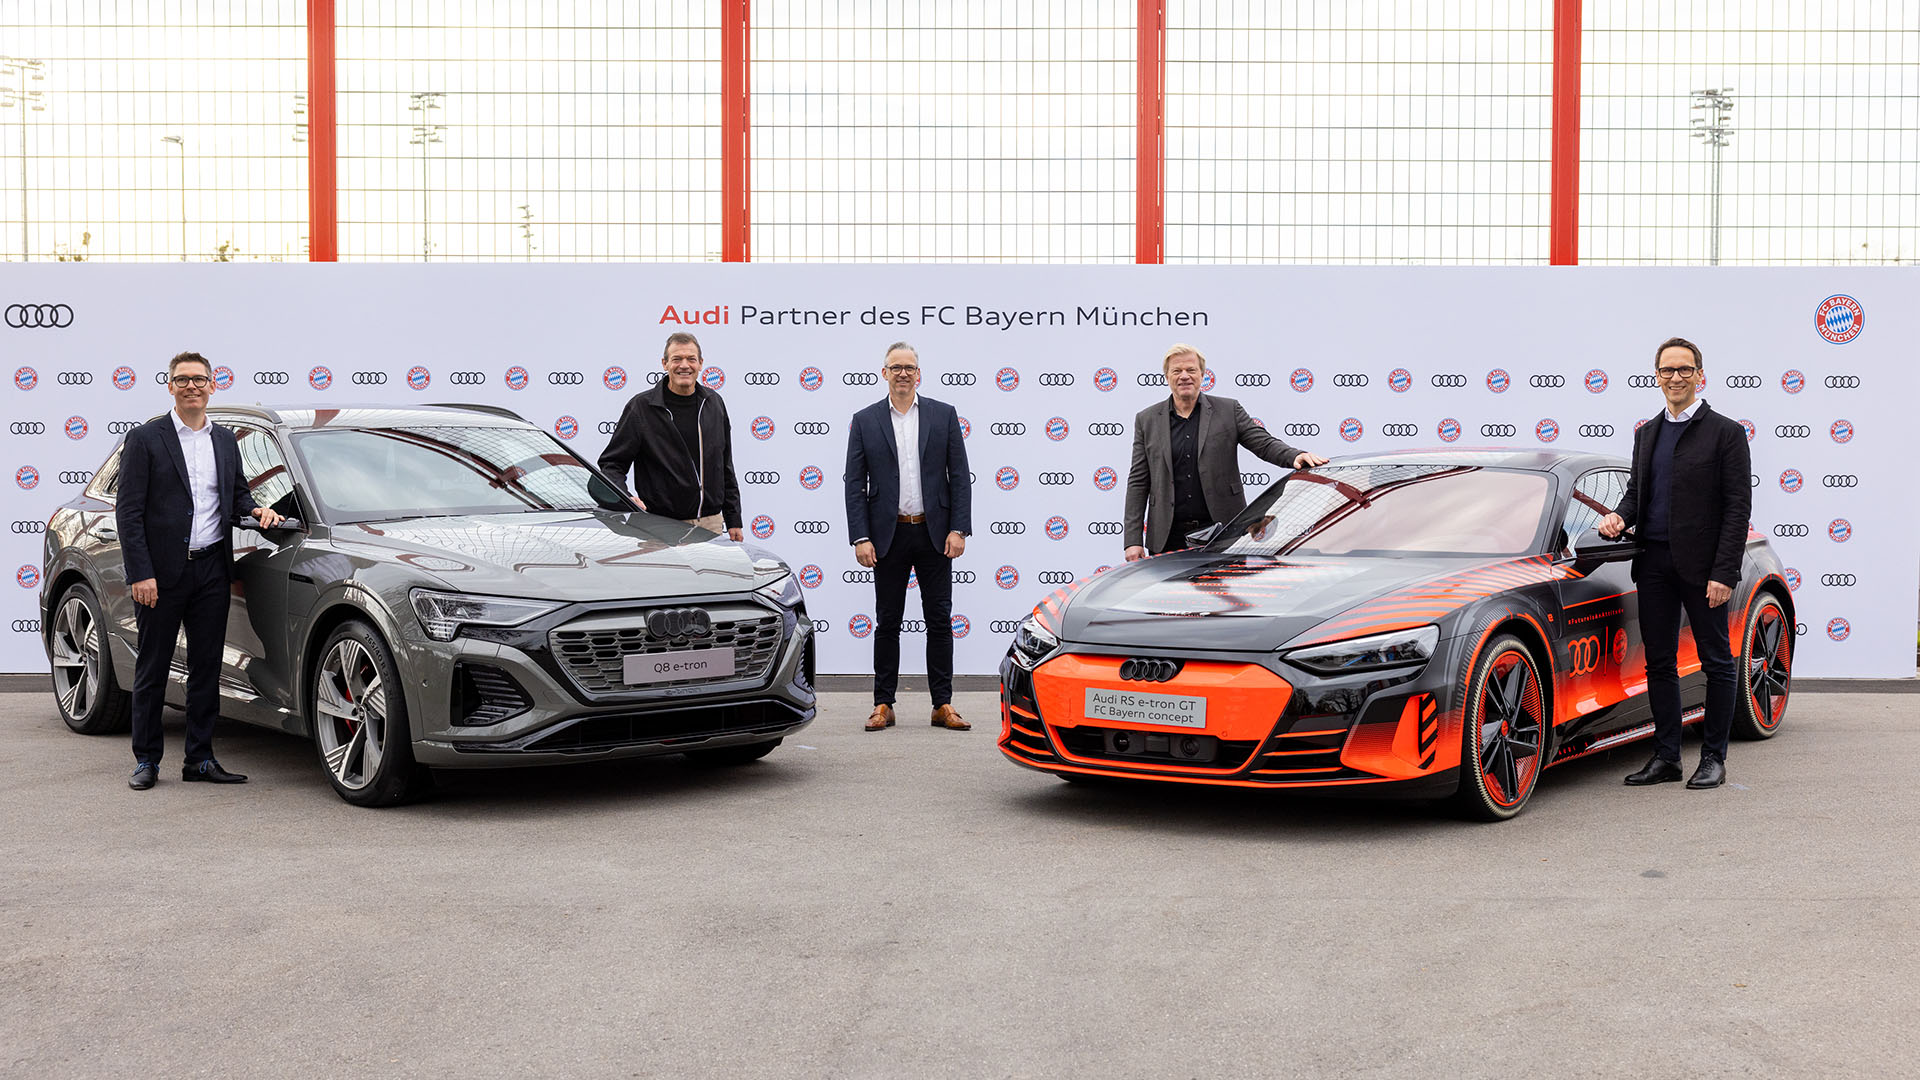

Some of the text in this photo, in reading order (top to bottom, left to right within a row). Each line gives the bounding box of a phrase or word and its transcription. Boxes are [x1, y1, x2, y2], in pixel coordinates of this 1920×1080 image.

[1819, 298, 1860, 316] FC BAYERN
[659, 305, 1208, 331] Audi Partner des FC Bayern München
[654, 661, 708, 673] Q8 e-tron
[1092, 693, 1196, 711] Audi RS e-tron GT
[1094, 705, 1194, 724] FC Bayern concept
